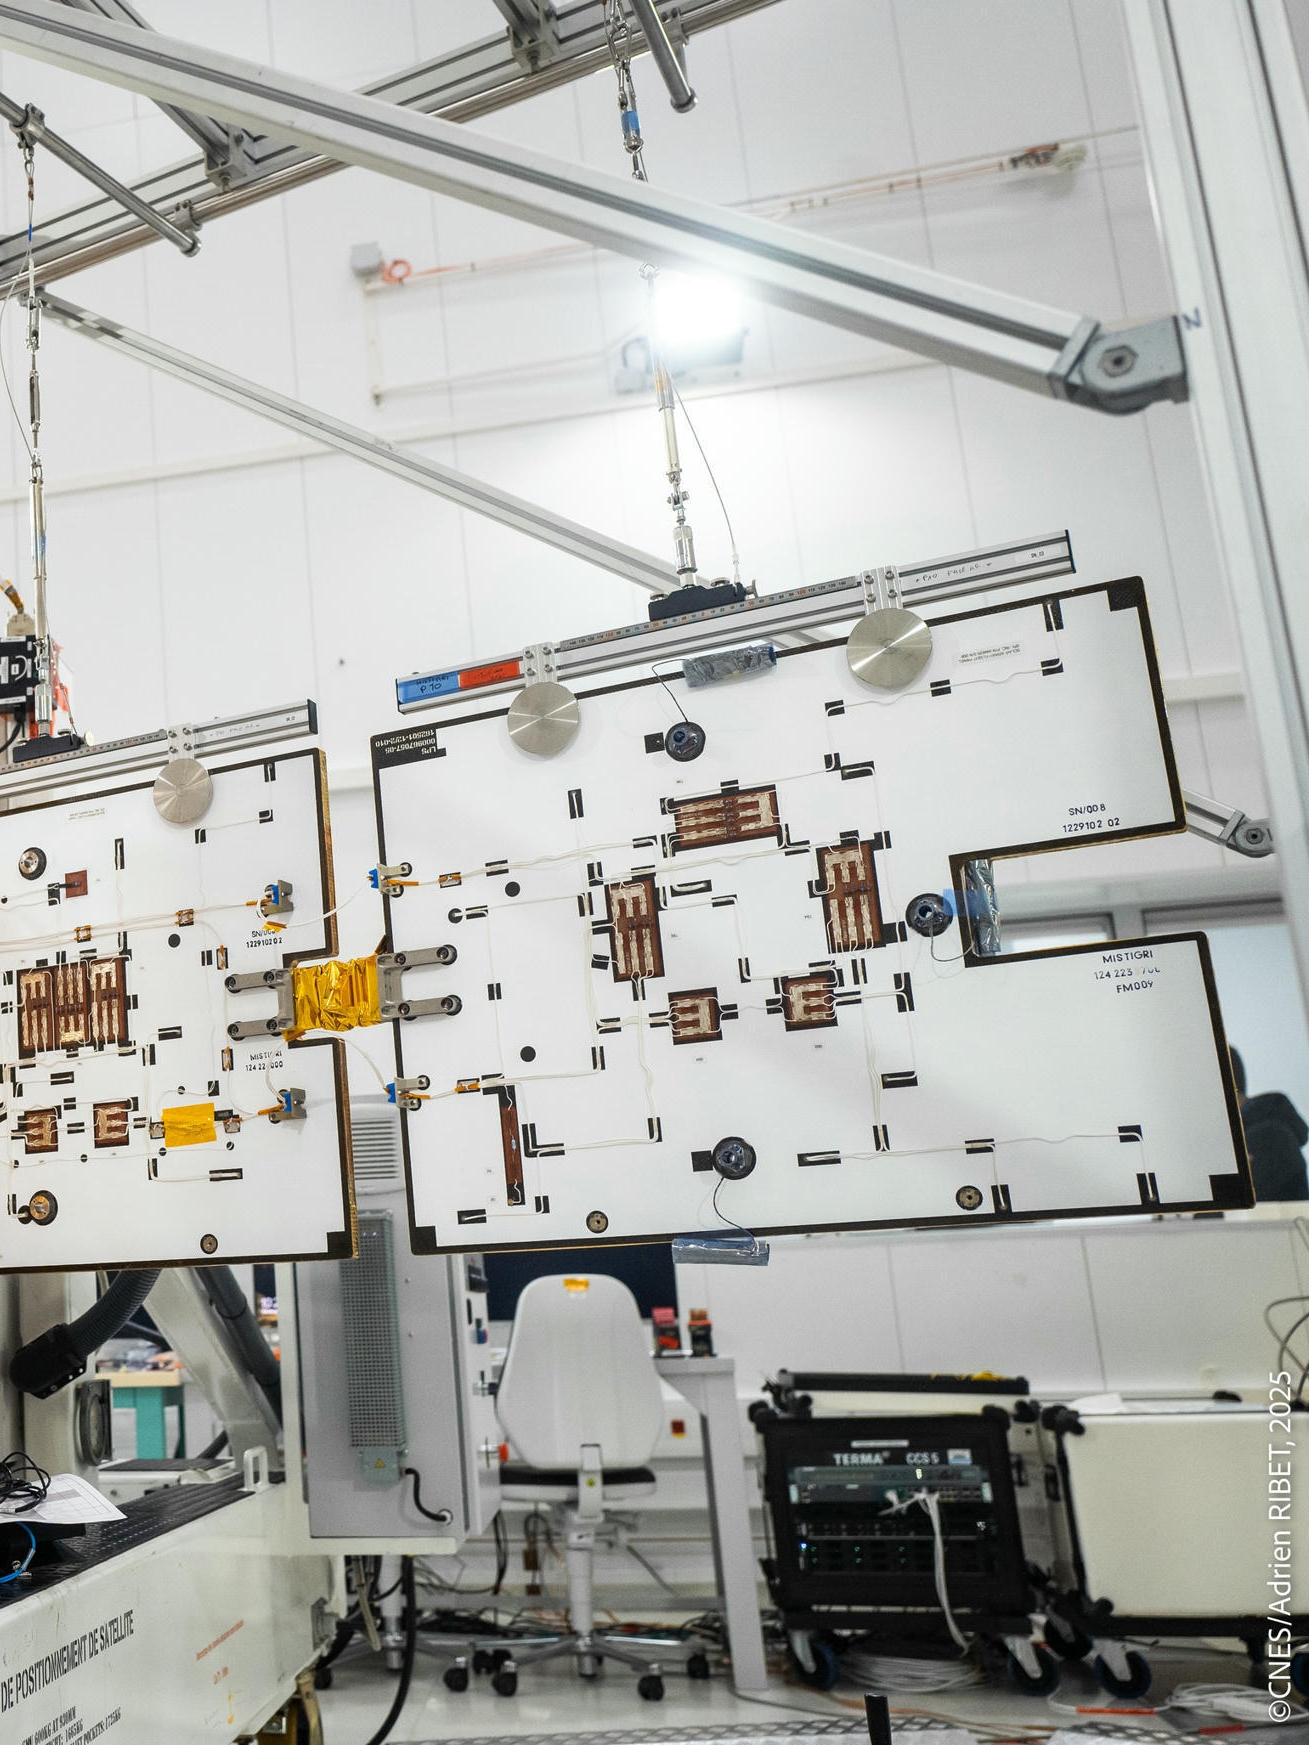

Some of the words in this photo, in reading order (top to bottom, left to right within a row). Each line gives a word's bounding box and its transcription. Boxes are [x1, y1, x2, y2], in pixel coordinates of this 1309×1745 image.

[1102, 950, 1153, 963] MISTIGRI
[1094, 970, 1111, 980] 124
[250, 1050, 283, 1061] MISTIRI
[833, 1453, 883, 1466] TERMA
[906, 1452, 930, 1465] CCS
[1, 1676, 14, 1714] DE
[15, 1634, 88, 1705] POSITIONNEMENT
[88, 1627, 99, 1660] DE
[99, 1609, 135, 1651] SATELLITE
